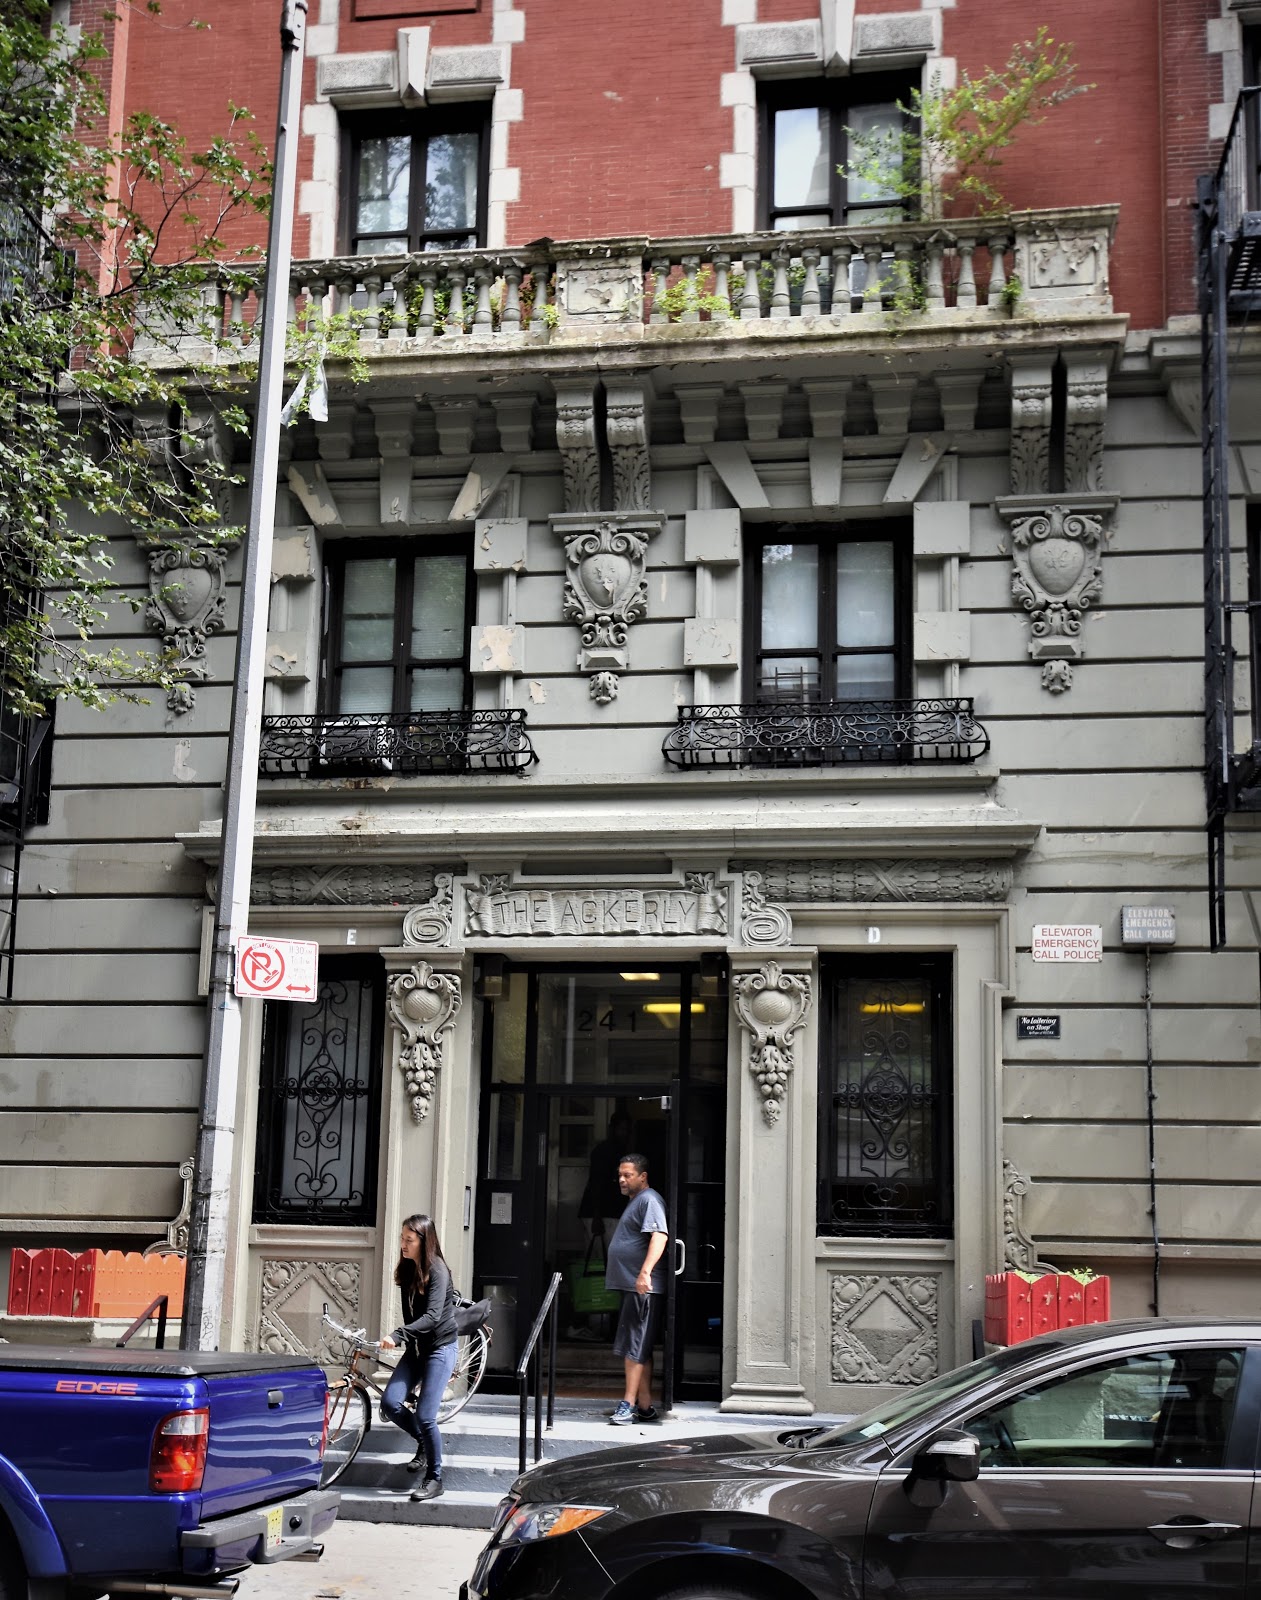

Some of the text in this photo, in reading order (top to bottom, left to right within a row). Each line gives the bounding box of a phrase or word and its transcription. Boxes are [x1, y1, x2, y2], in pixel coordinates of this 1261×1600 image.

[493, 899, 697, 925] THE ACKERLY
[1128, 908, 1169, 918] ELEVATOR
[1125, 918, 1173, 928] EMERGENCY
[347, 929, 357, 945] E
[868, 926, 880, 943] D
[1041, 927, 1092, 937] ELEVATOR
[1124, 929, 1174, 939] CALL POLICE
[1034, 939, 1099, 948] EMERGENCY
[1033, 950, 1101, 960] CALL POLICE
[577, 1010, 637, 1032] 241
[56, 1380, 138, 1395] EDGE
